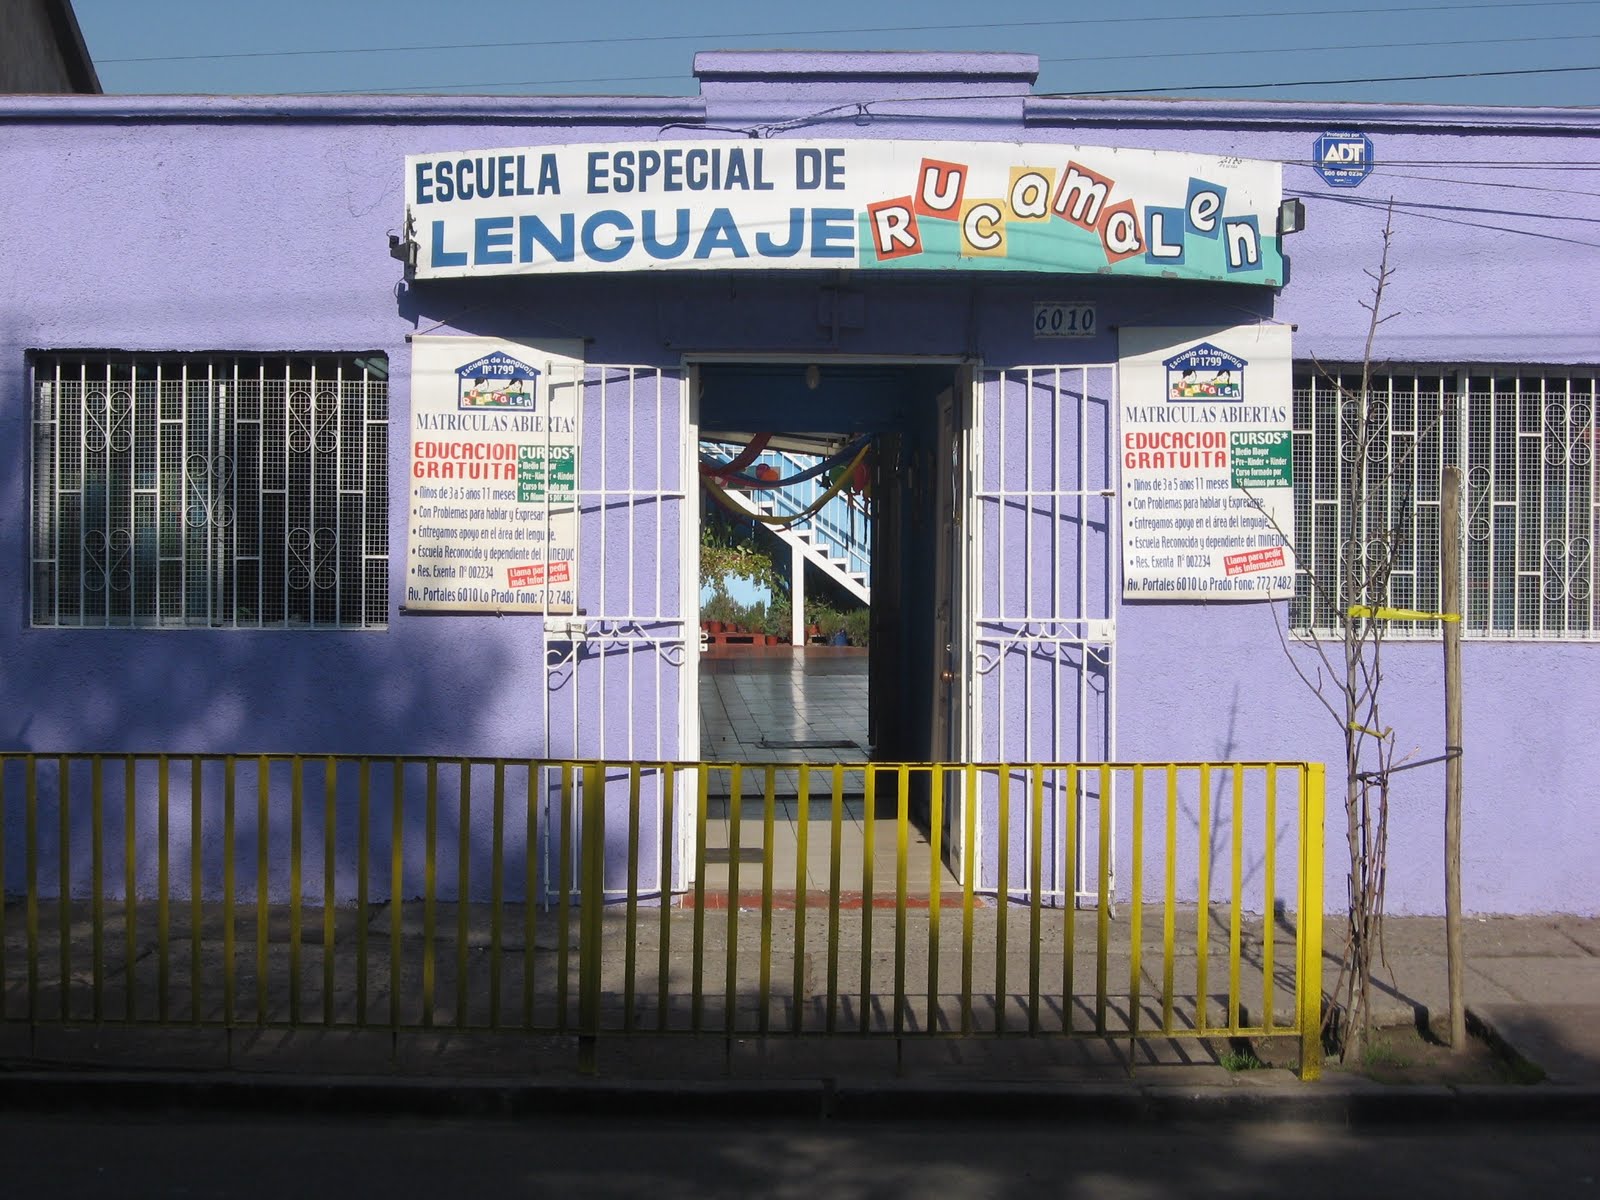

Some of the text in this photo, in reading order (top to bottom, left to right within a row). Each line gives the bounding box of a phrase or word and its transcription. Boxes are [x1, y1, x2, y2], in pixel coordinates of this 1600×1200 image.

[1324, 143, 1364, 164] ADT
[415, 148, 846, 204] ESCUELA ESPECIAL DE
[431, 207, 855, 268] LENGUAJE
[1036, 308, 1094, 330] 6010
[1169, 350, 1197, 369] Escuela
[1210, 348, 1242, 368] Lenguaje
[1201, 357, 1222, 366] 1799
[461, 357, 490, 377] Escuela
[493, 365, 514, 374] 1799
[416, 412, 508, 432] MATRICULAS
[1126, 406, 1286, 424] MATRICULAS ABIERTAS
[1125, 432, 1226, 450] EDUCACION
[414, 441, 517, 460] EDUCACION
[1125, 451, 1226, 469] GRATUITA
[413, 460, 516, 480] GRATUITA
[1273, 469, 1282, 477] por
[1152, 478, 1162, 490] de
[1196, 477, 1204, 490] 11
[1206, 479, 1228, 490] meses
[439, 486, 448, 500] de
[482, 487, 490, 500] 11
[492, 490, 516, 501] meses
[523, 492, 529, 501] 15
[1134, 497, 1146, 510] Con
[1147, 496, 1182, 510] Problemas
[1184, 499, 1198, 511] para
[1200, 496, 1221, 508] hablar
[419, 506, 432, 518] Con
[433, 506, 468, 520] Problemas
[470, 509, 484, 521] para
[486, 507, 508, 520] hablar
[1134, 516, 1174, 531] Entregamos
[1174, 518, 1194, 531] apoyo
[1196, 518, 1204, 528] en
[1206, 516, 1212, 528] el
[1213, 516, 1228, 528] área
[1229, 516, 1238, 528] del
[418, 525, 458, 540] Entregamos
[459, 528, 480, 541] apoyo
[481, 528, 489, 539] en
[490, 526, 496, 540] el
[498, 526, 512, 540] área
[514, 528, 524, 540] del
[1136, 536, 1160, 549] Escuela
[1162, 536, 1198, 548] Reconocida
[1206, 536, 1245, 550] dependiente
[1246, 535, 1256, 548] del
[418, 545, 443, 558] Escuela
[444, 546, 482, 559] Reconocida
[490, 547, 530, 561] dependiente
[531, 548, 541, 560] del
[543, 548, 574, 561] INEDUC
[1248, 552, 1264, 564] para
[1136, 556, 1150, 568] Res.
[1152, 556, 1174, 568] Exenta
[1186, 555, 1211, 568] 002234
[418, 564, 432, 578] Res.
[433, 565, 456, 578] Exenta
[468, 566, 494, 578] 002234
[532, 566, 544, 576] par
[526, 574, 568, 584] Inforación
[1128, 576, 1292, 591] Av. Portales 6010 Lo Prado Fono: 772 7482
[408, 586, 420, 600] Av.
[424, 587, 456, 602] Portales
[458, 588, 478, 602] 6010
[480, 588, 488, 602] Lo
[491, 588, 514, 603] Prado
[516, 590, 538, 604] Fono:
[540, 590, 554, 604] 72
